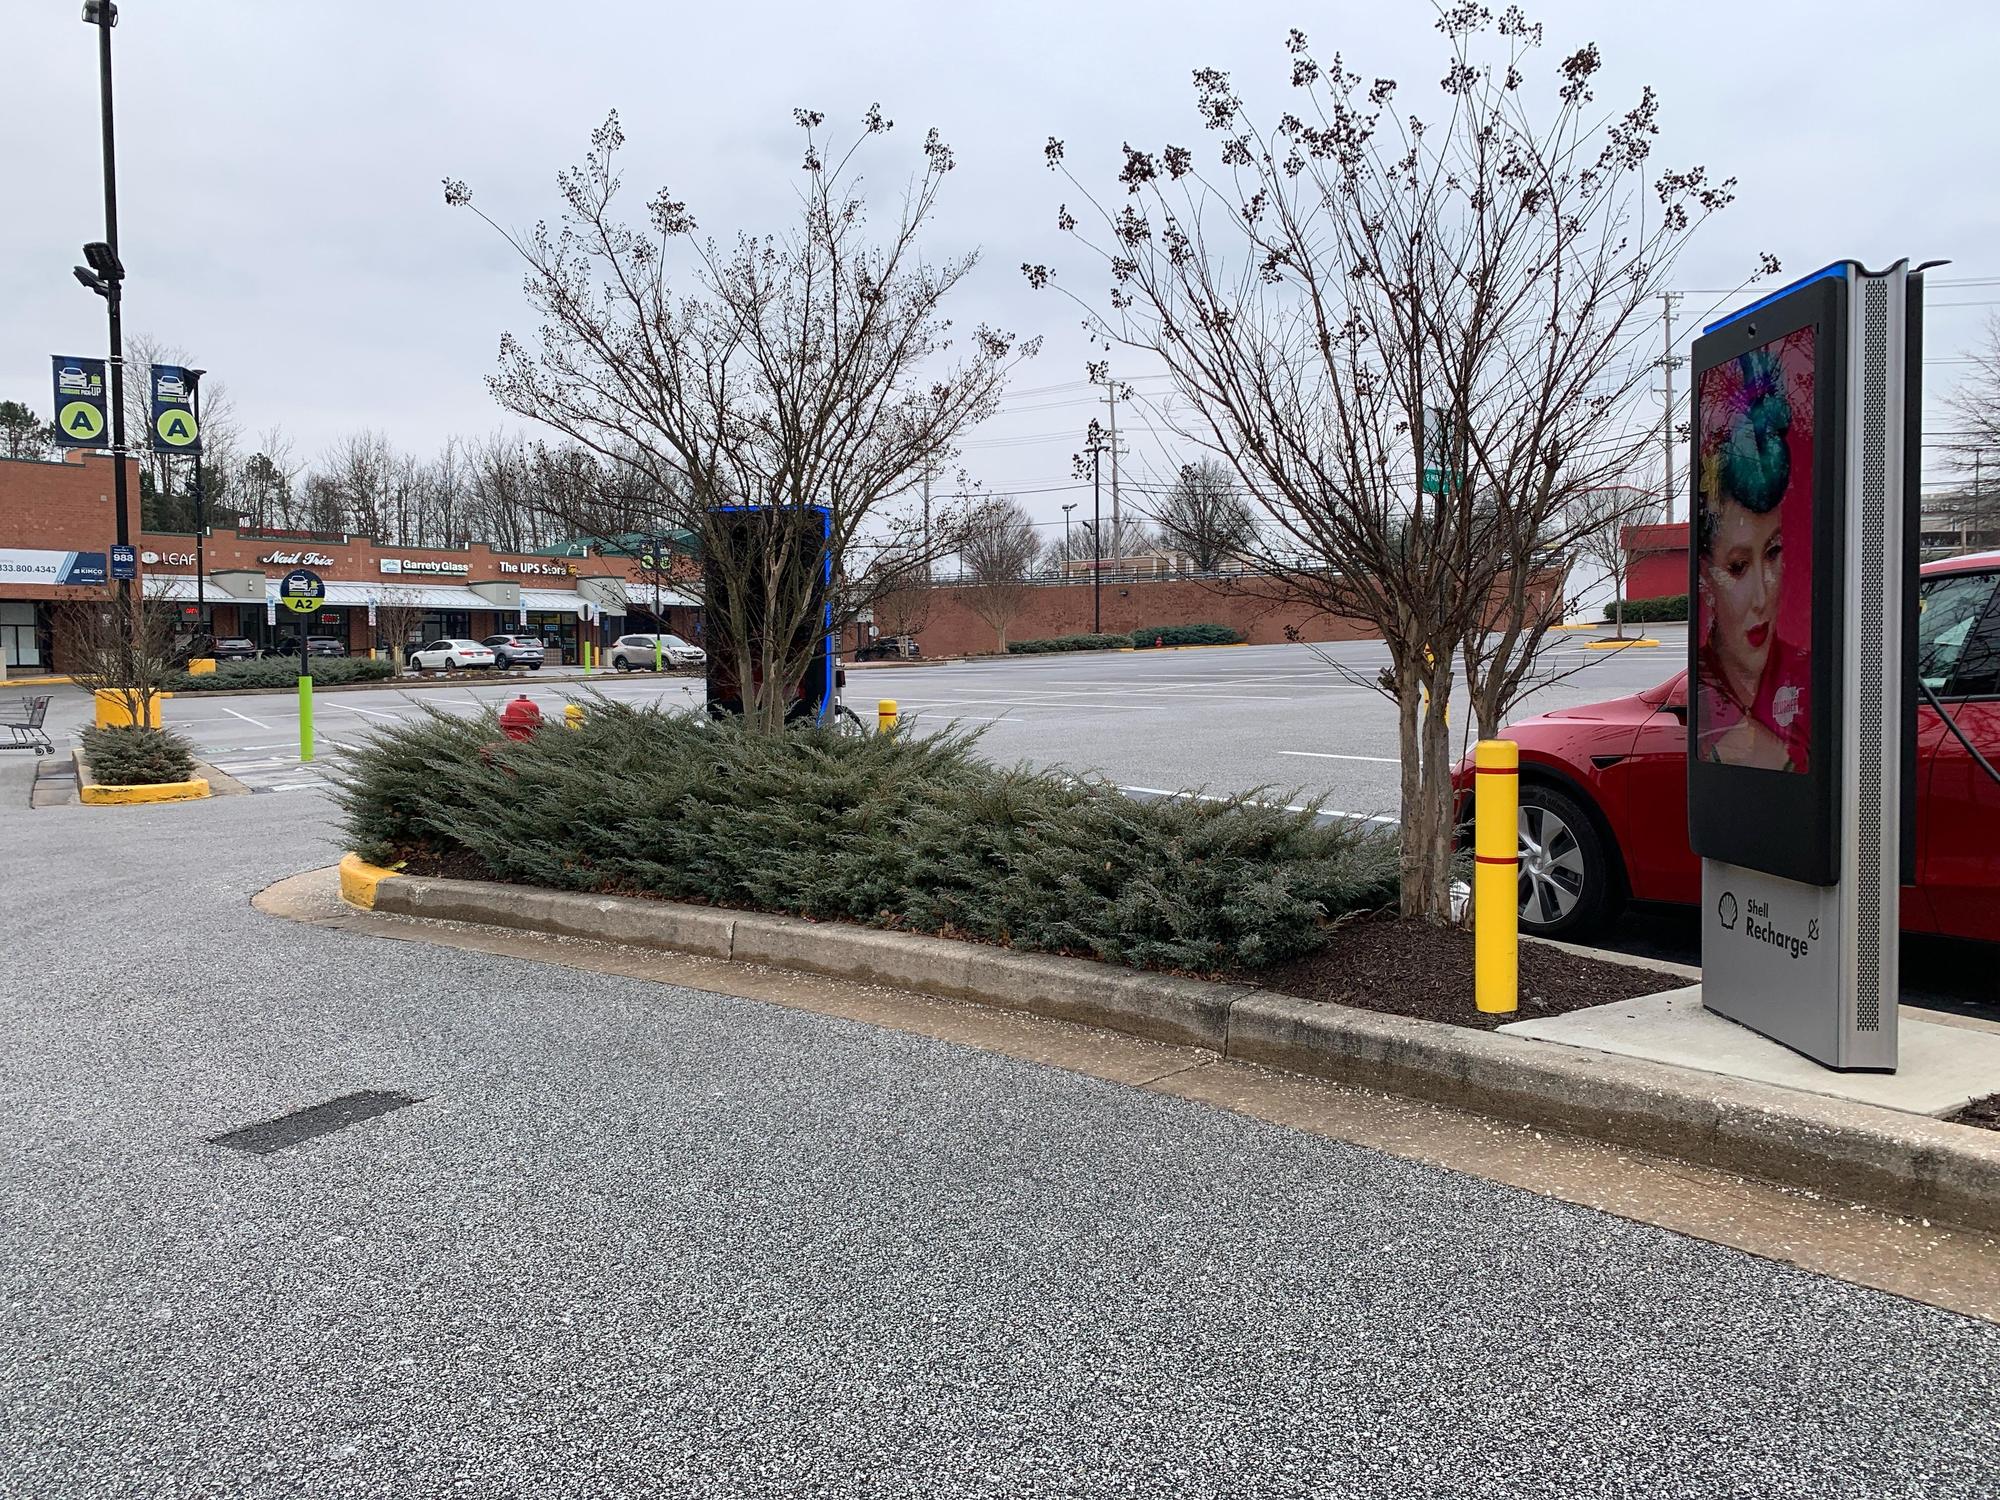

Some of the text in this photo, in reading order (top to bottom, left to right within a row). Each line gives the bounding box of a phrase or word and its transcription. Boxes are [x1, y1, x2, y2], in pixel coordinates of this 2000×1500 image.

[70, 411, 94, 431] A
[167, 419, 189, 438] A
[113, 554, 134, 562] 988
[263, 550, 335, 566] Nail Trix
[403, 560, 469, 572] Garrety Glass
[500, 561, 518, 573] The
[520, 562, 540, 574] UPS
[295, 600, 313, 609] A2
[1747, 898, 1769, 919] Shell
[1746, 916, 1809, 960] Recharge
